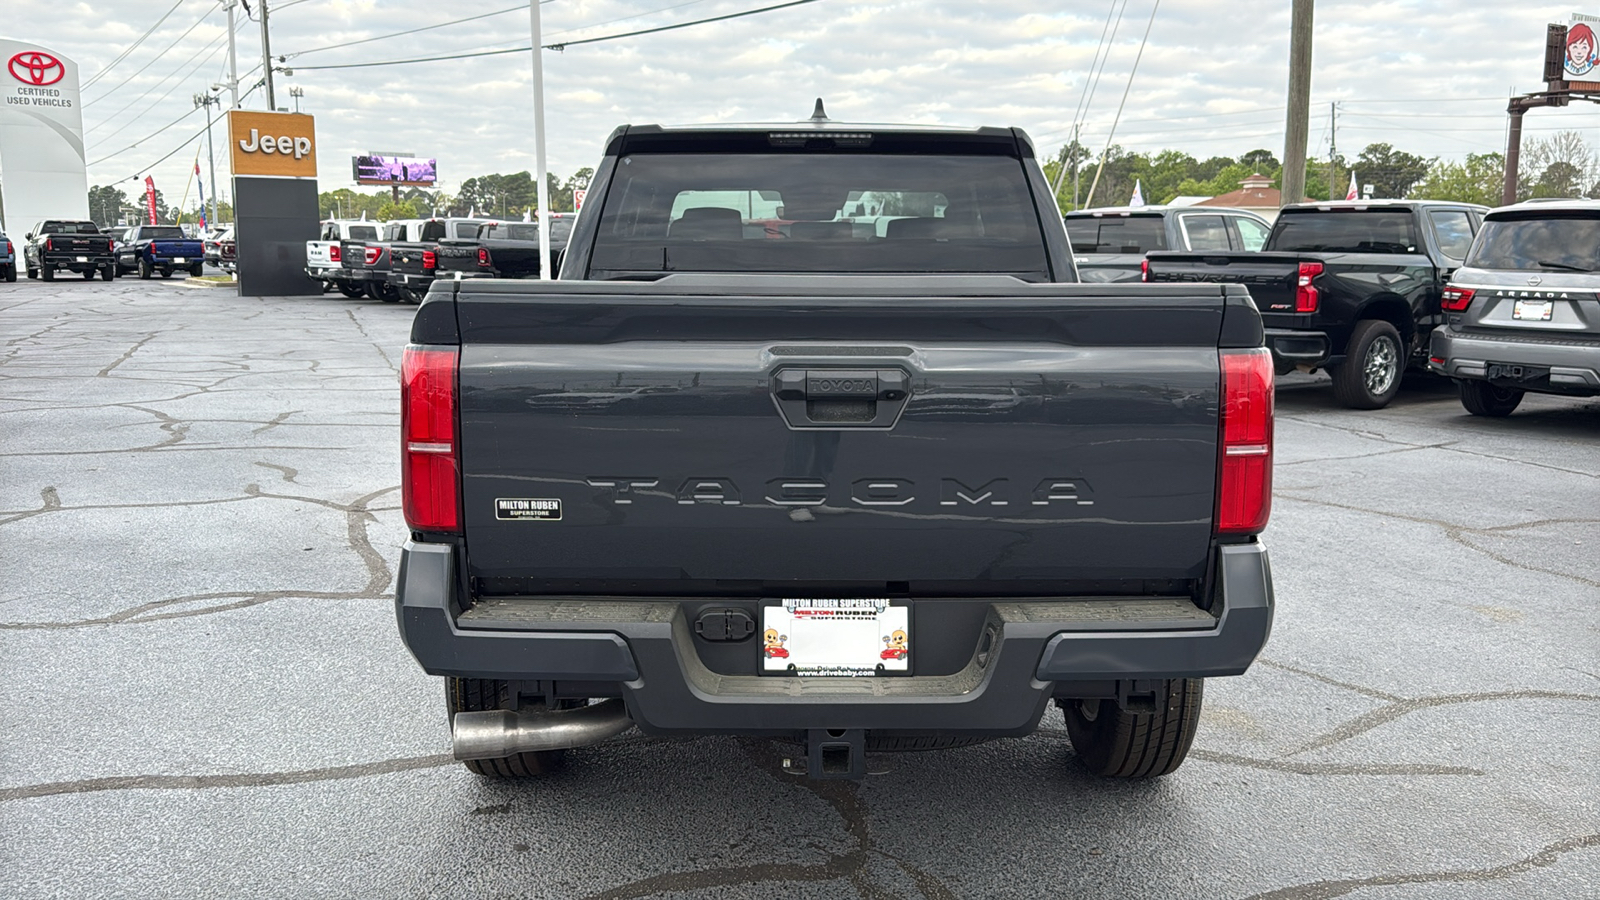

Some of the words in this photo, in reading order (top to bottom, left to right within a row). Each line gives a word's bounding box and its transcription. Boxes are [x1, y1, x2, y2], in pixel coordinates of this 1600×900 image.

[17, 87, 60, 97] CERTIFIED
[7, 96, 30, 105] USED
[32, 97, 72, 108] VEHICLES
[239, 128, 312, 160] Jeep
[1496, 290, 1568, 299] ARMADA
[810, 379, 874, 392] TOYOTA
[586, 477, 1094, 506] TACOMA
[499, 500, 529, 510] MILTON
[530, 500, 558, 510] RUBEN
[782, 598, 811, 607] MILTON
[812, 598, 839, 607] RUBEN
[840, 598, 890, 607] SUPERSTORE
[797, 669, 875, 677] www.drivebaby.com
